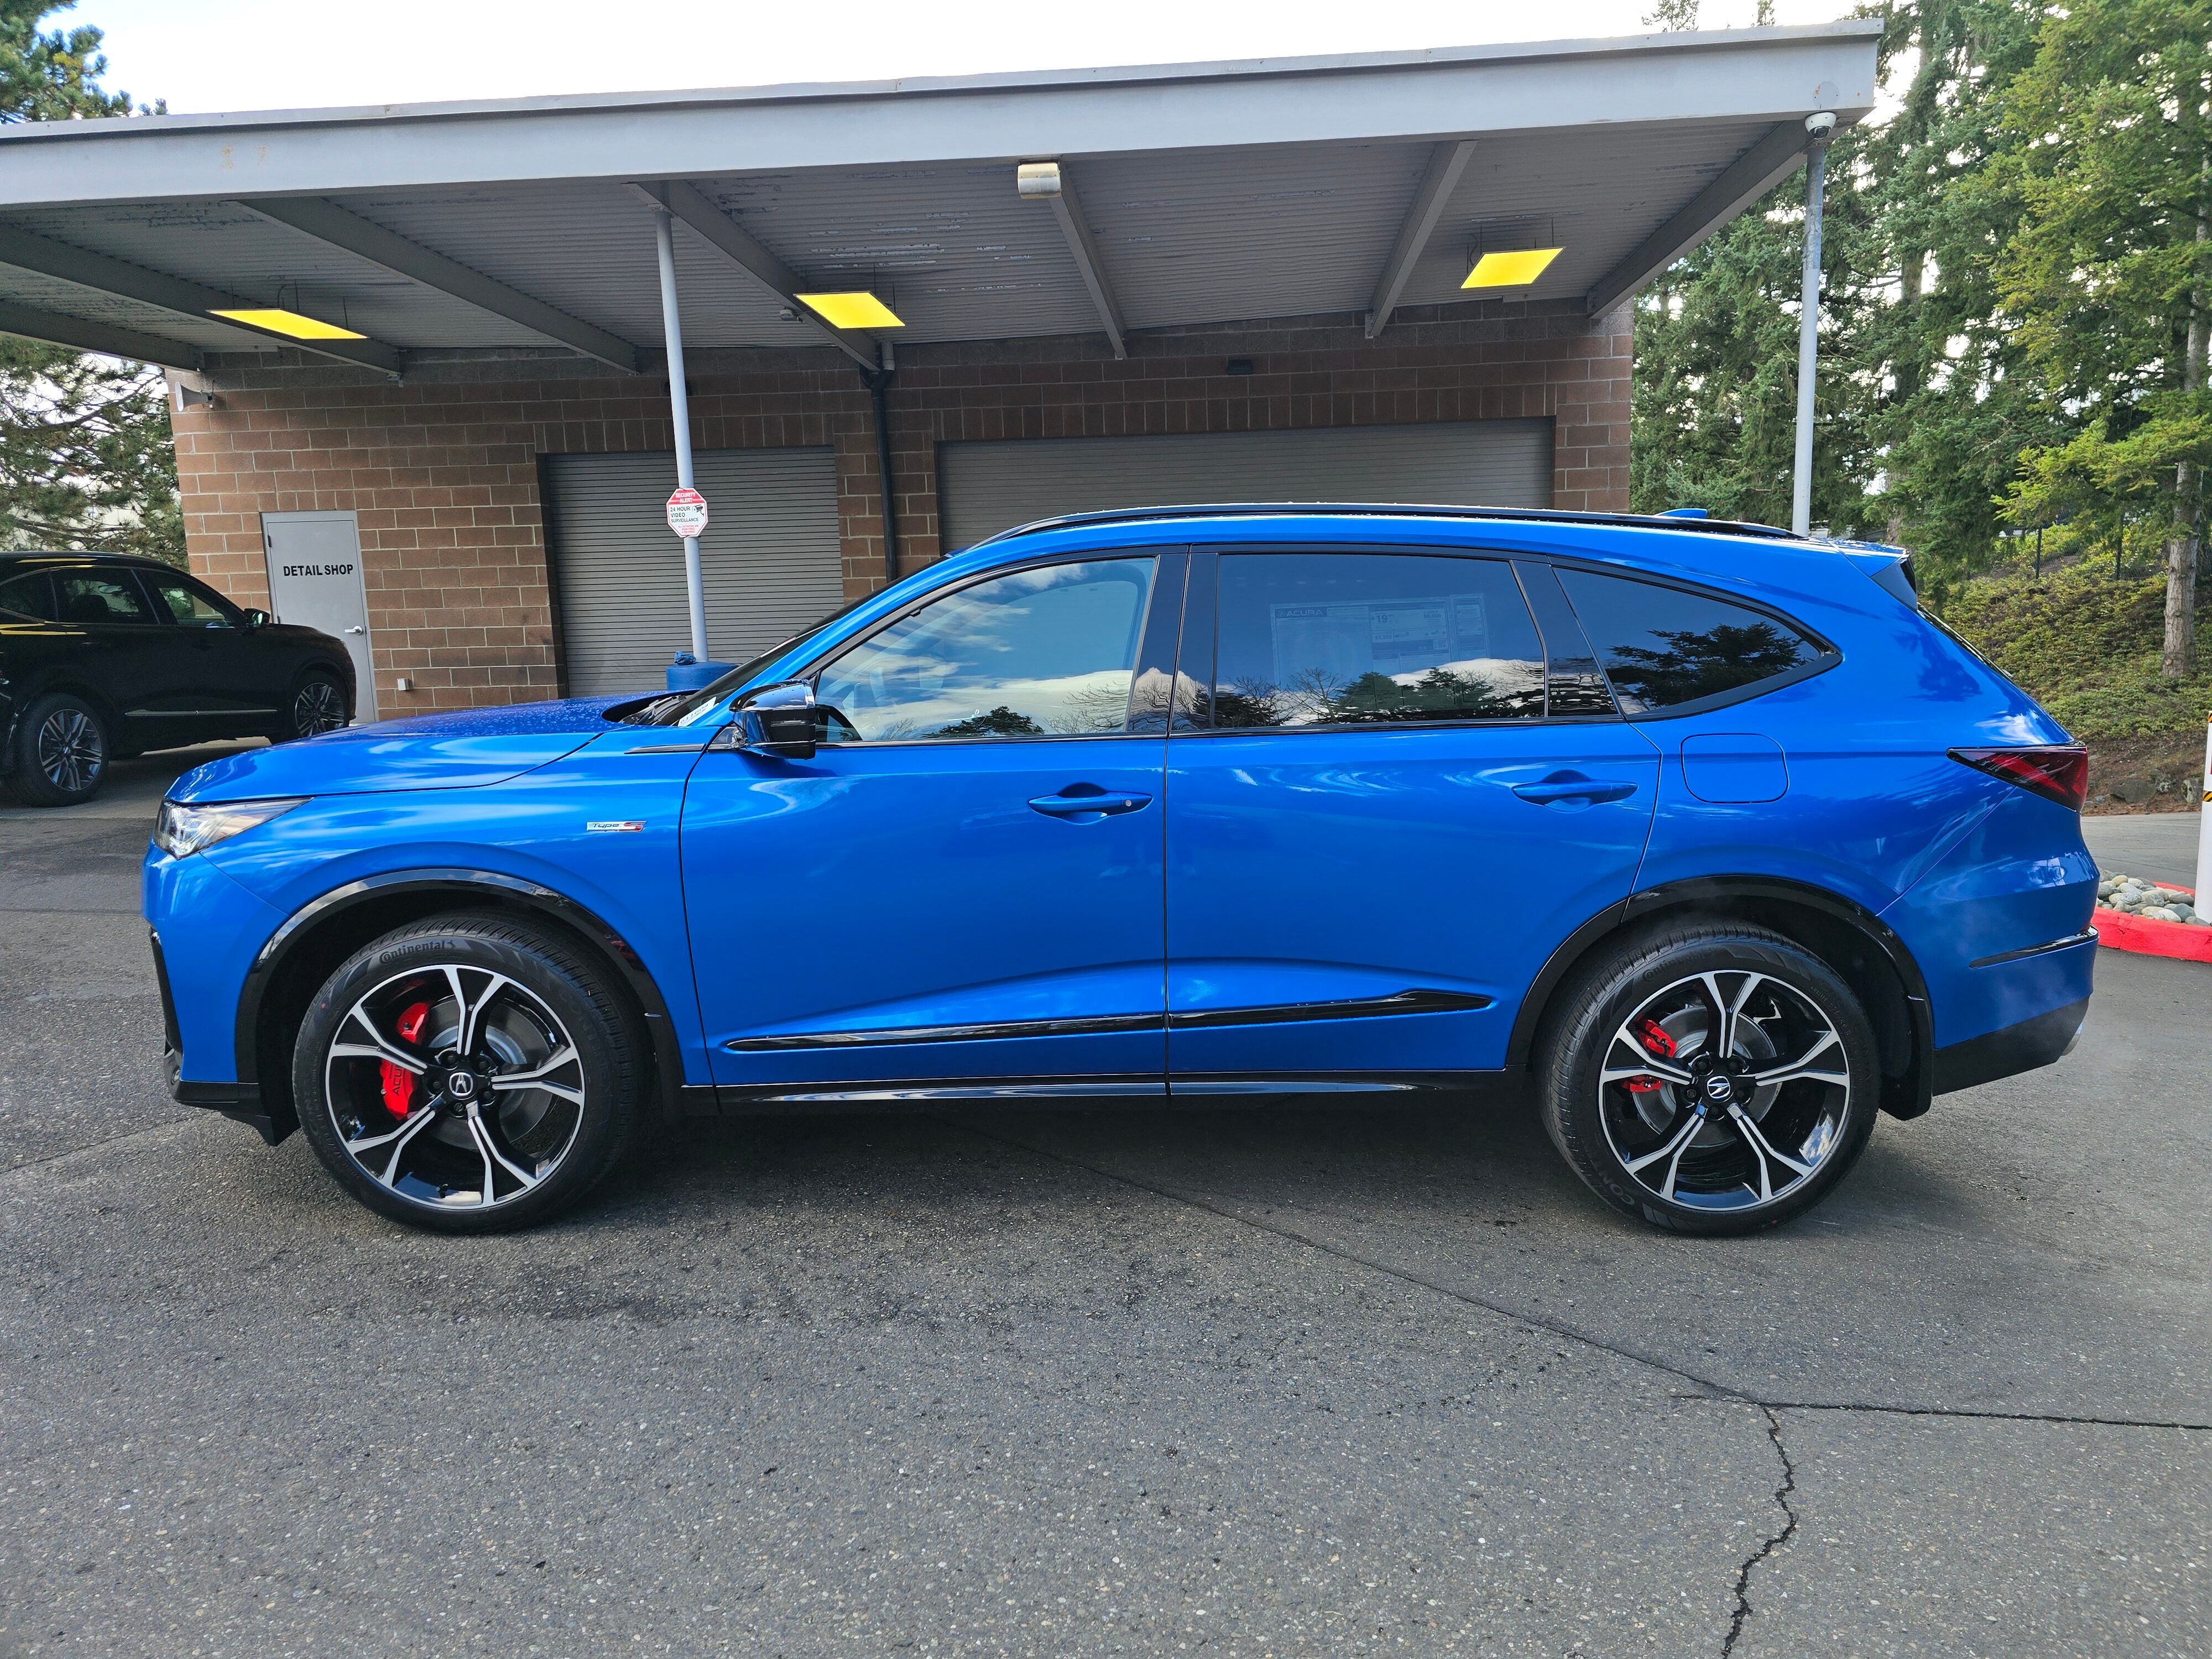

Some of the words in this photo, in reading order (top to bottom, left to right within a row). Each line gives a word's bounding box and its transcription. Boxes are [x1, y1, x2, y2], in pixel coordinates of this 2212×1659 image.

[283, 565, 323, 576] DETAIL
[324, 564, 353, 576] SHOP
[1376, 614, 1388, 623] 19
[619, 821, 647, 832] S
[379, 940, 445, 964] Continental
[392, 1067, 403, 1096] ACU
